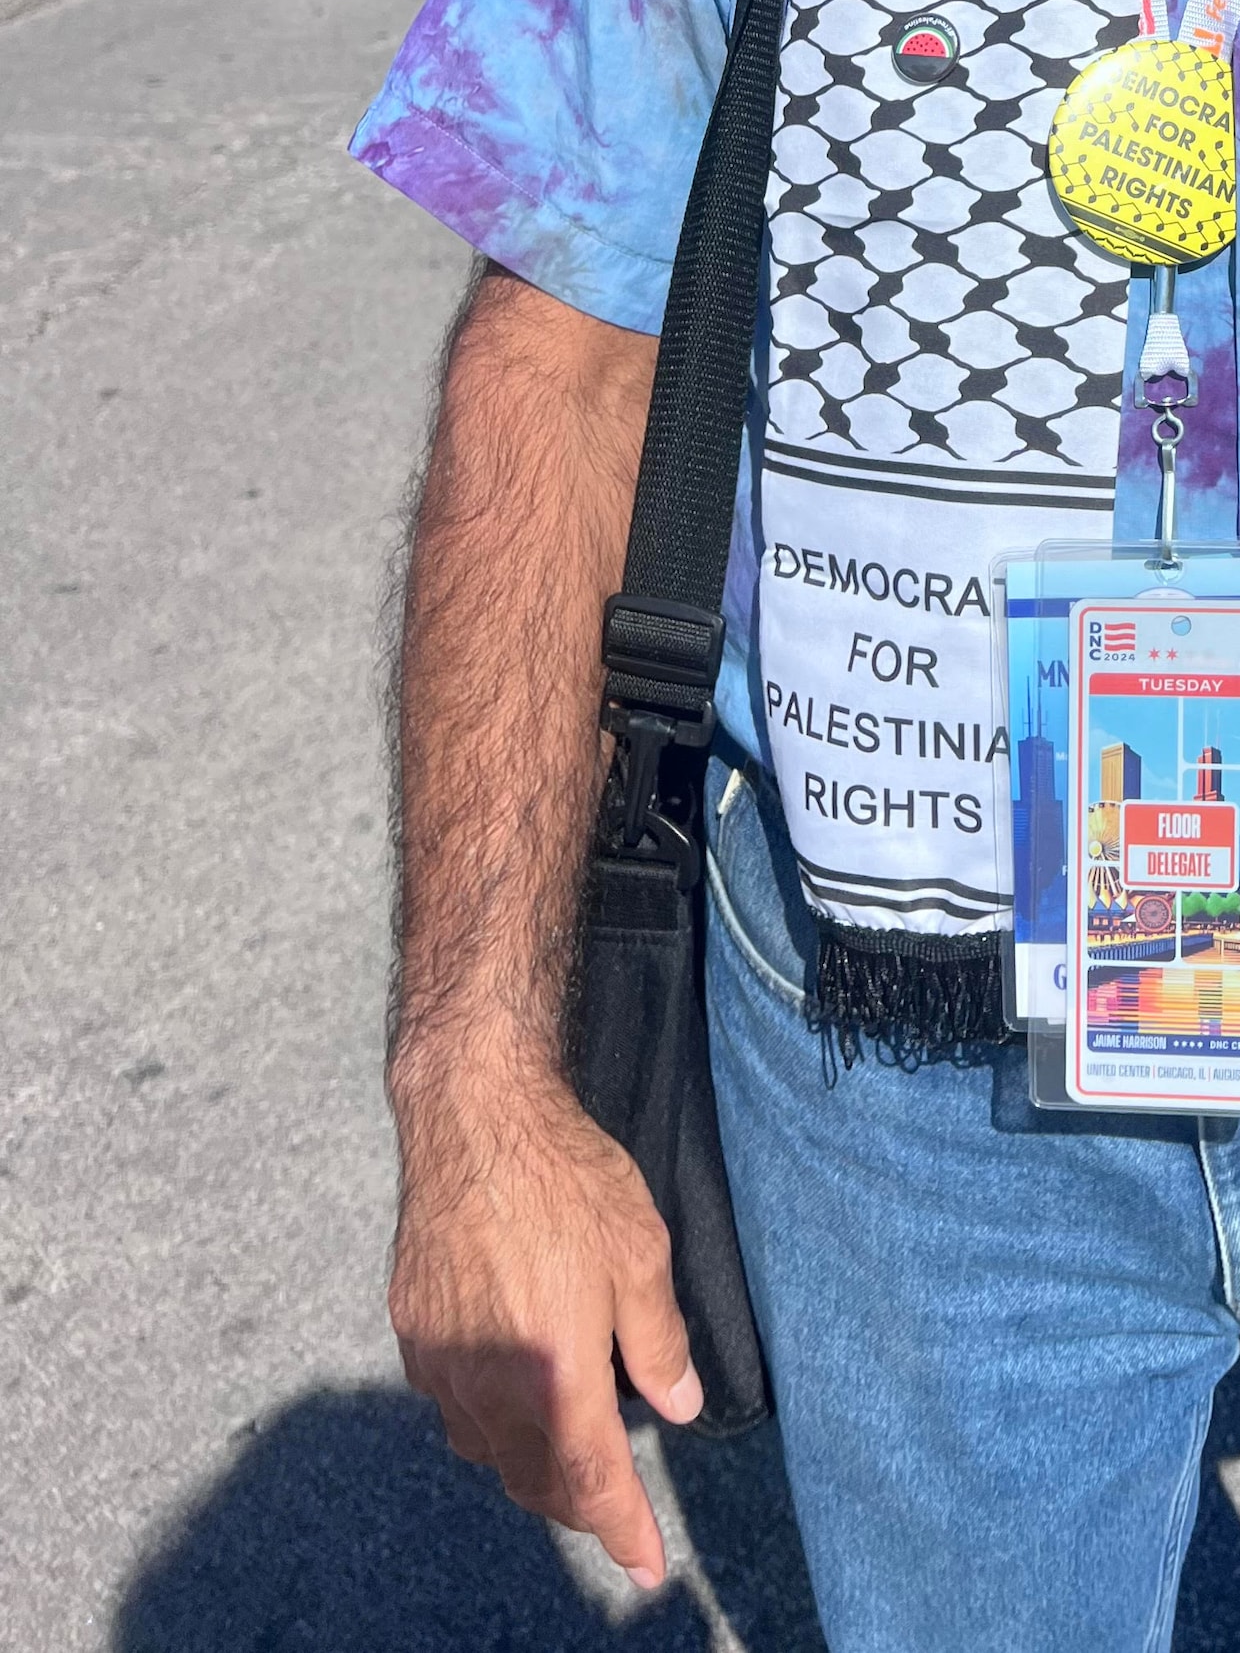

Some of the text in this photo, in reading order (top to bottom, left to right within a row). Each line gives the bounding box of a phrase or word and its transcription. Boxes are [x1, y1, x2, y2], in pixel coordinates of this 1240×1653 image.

[1144, 113, 1196, 151] FOR
[1078, 121, 1236, 203] PALESTINIAN
[1099, 165, 1193, 219] RIGHTS
[774, 542, 1006, 617] DEMOCRA
[847, 632, 939, 688] FOR
[1089, 621, 1102, 661] DNC
[1103, 652, 1136, 662] 2024
[1138, 678, 1223, 693] TUESDAY
[805, 771, 982, 833] RIGHTS
[1157, 812, 1201, 839] FLOOR
[1147, 851, 1212, 877] DELEGATE
[1092, 1034, 1121, 1048] JAIME
[1122, 1035, 1167, 1050] HARRISON
[1209, 1040, 1229, 1050] DNC
[1086, 1063, 1117, 1077] UNITED
[1118, 1064, 1151, 1078] CENTER
